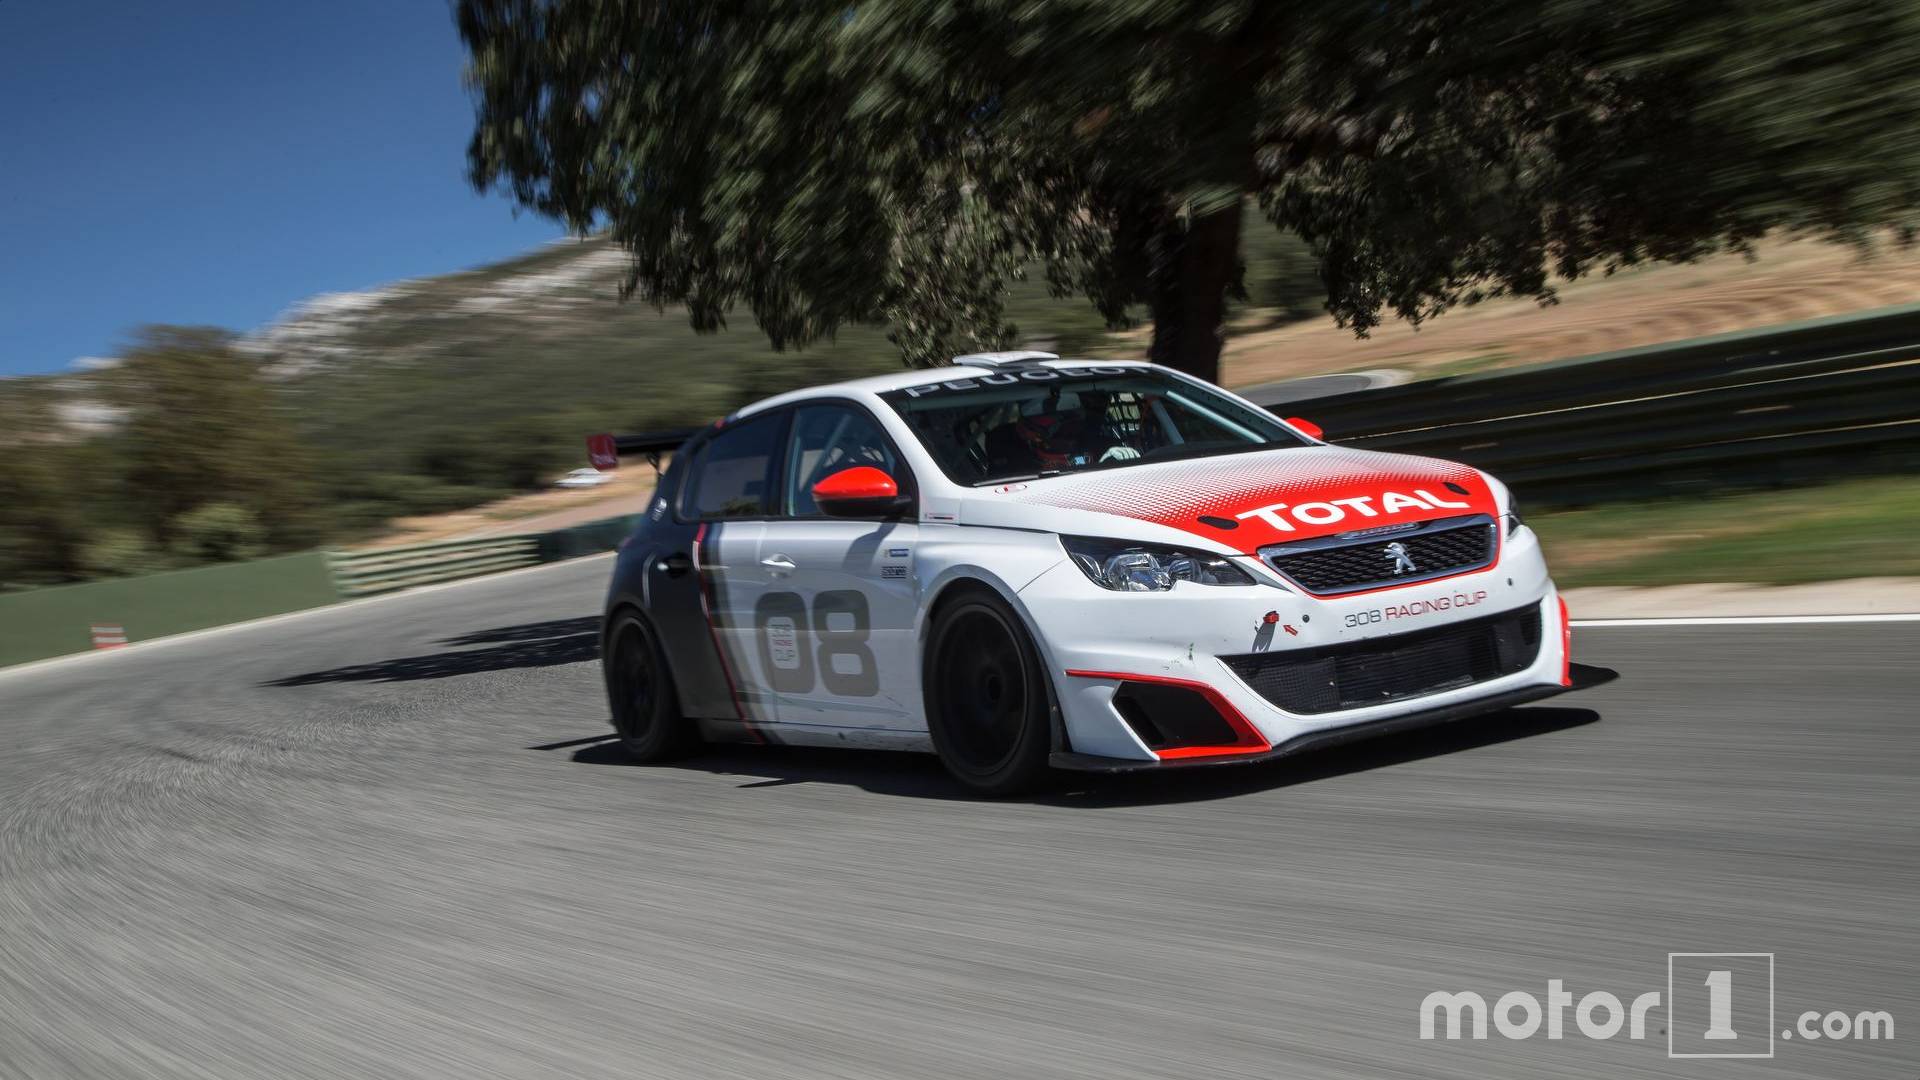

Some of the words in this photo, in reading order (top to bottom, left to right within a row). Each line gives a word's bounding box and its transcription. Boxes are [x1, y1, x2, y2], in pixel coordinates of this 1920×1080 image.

[904, 366, 1149, 397] PEUGEOT
[1235, 489, 1471, 531] TOTAL
[1344, 609, 1382, 628] 308
[1385, 597, 1451, 620] RACING
[1453, 590, 1488, 608] CUP
[754, 589, 879, 697] 08
